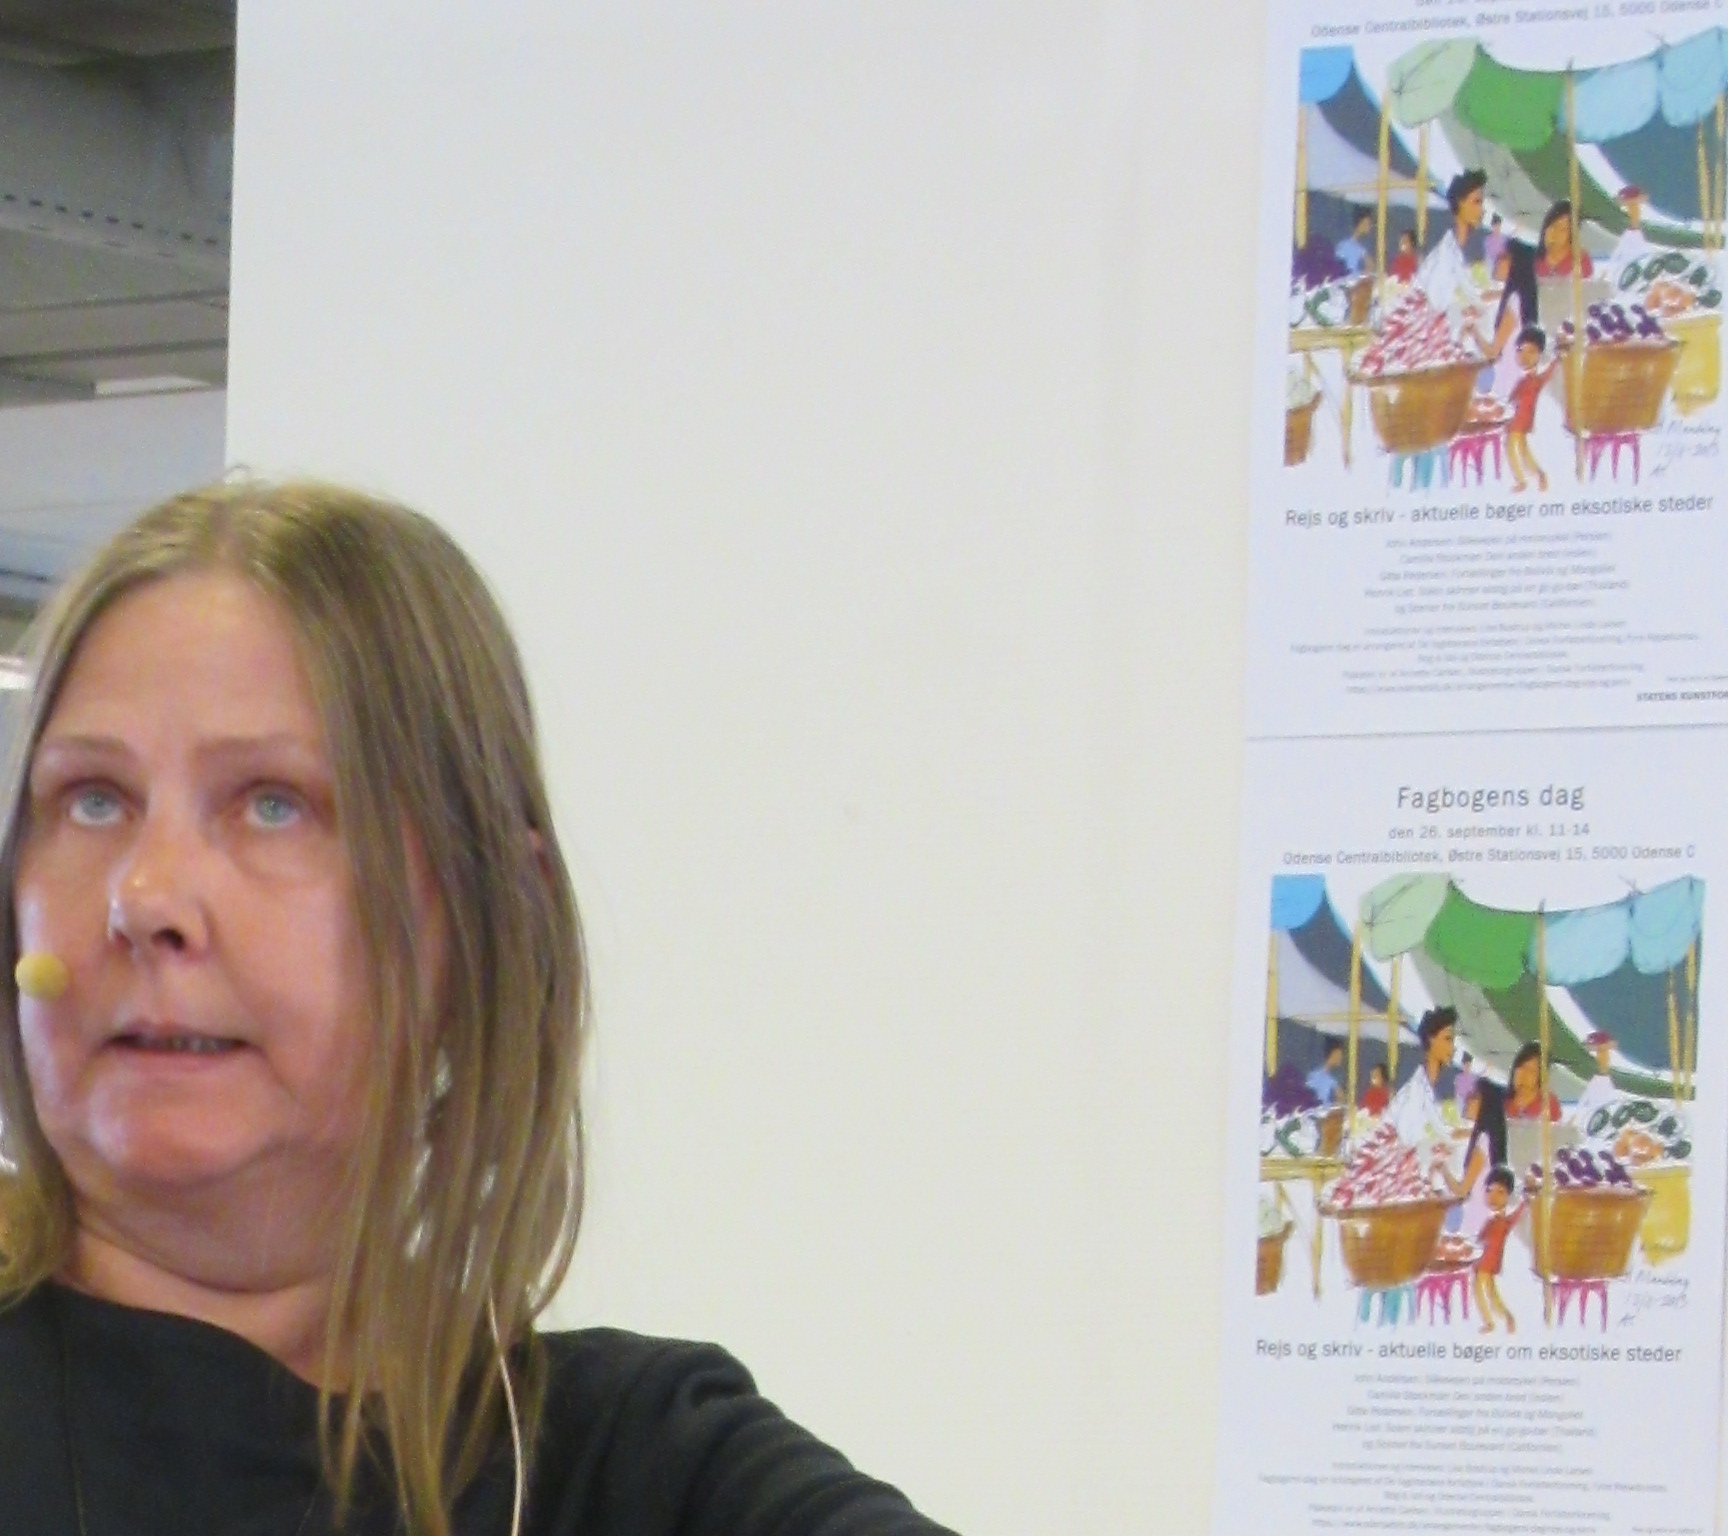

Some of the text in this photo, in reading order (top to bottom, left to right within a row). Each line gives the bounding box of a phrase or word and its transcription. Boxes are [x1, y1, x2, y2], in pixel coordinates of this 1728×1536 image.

[1285, 508, 1321, 529] Rejs
[1328, 509, 1348, 528] og
[1353, 506, 1394, 525] skriv
[1411, 503, 1480, 522] aktuelle
[1485, 501, 1532, 522] bøger
[1538, 502, 1565, 517] om
[1571, 496, 1653, 516] eksotiske
[1658, 494, 1713, 513] steder
[1397, 783, 1585, 814] Fagbogens dag
[1388, 825, 1414, 839] den
[1419, 825, 1442, 839] 26.
[1446, 823, 1521, 841] september
[1283, 851, 1333, 865] Odense
[1335, 848, 1443, 864] Centralbibliotek,
[1447, 848, 1483, 862] Østre
[1487, 847, 1560, 863] Stationsvej
[1591, 845, 1628, 860] 5000
[1632, 844, 1682, 859] Odense
[1686, 844, 1696, 857] C
[1255, 1339, 1291, 1360] Rejs
[1296, 1342, 1317, 1361] og
[1321, 1340, 1363, 1358] skriv
[1378, 1341, 1447, 1359] aktuelle
[1452, 1342, 1501, 1363] bøger
[1506, 1345, 1533, 1360] om
[1538, 1343, 1621, 1362] eksotiske
[1625, 1345, 1683, 1363] steder
